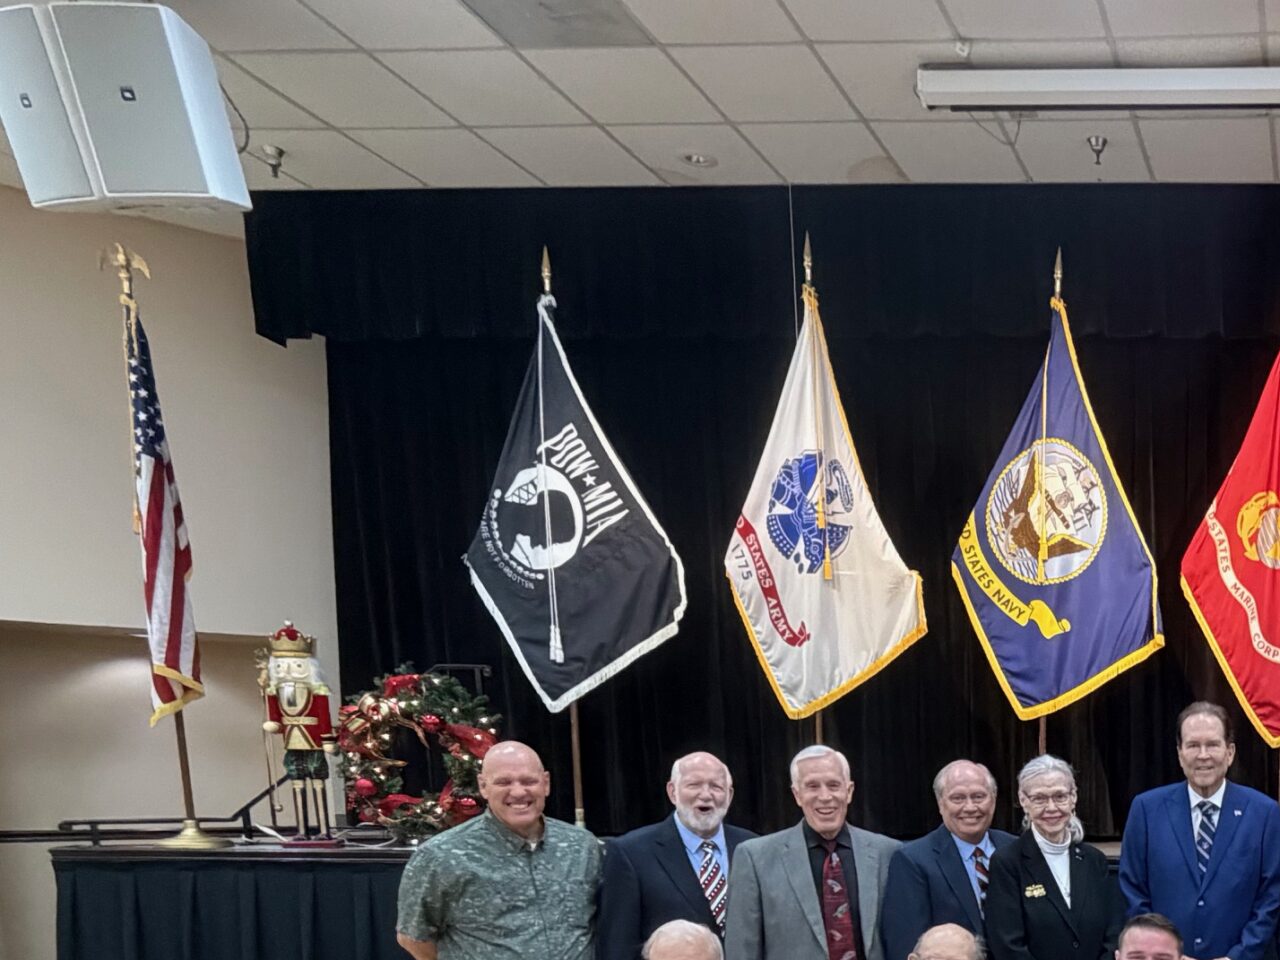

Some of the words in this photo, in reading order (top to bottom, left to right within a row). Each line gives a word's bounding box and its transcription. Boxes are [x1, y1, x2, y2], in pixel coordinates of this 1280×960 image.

[536, 422, 600, 480] POW
[581, 481, 630, 548] MIA
[485, 540, 498, 557] NOT
[731, 543, 753, 581] 1775
[746, 533, 774, 588] STATES
[767, 596, 793, 640] ARMY
[964, 545, 993, 589] STATES
[992, 589, 1026, 619] NAVY
[1209, 522, 1231, 573] STATES
[1230, 582, 1257, 624] MARINE
